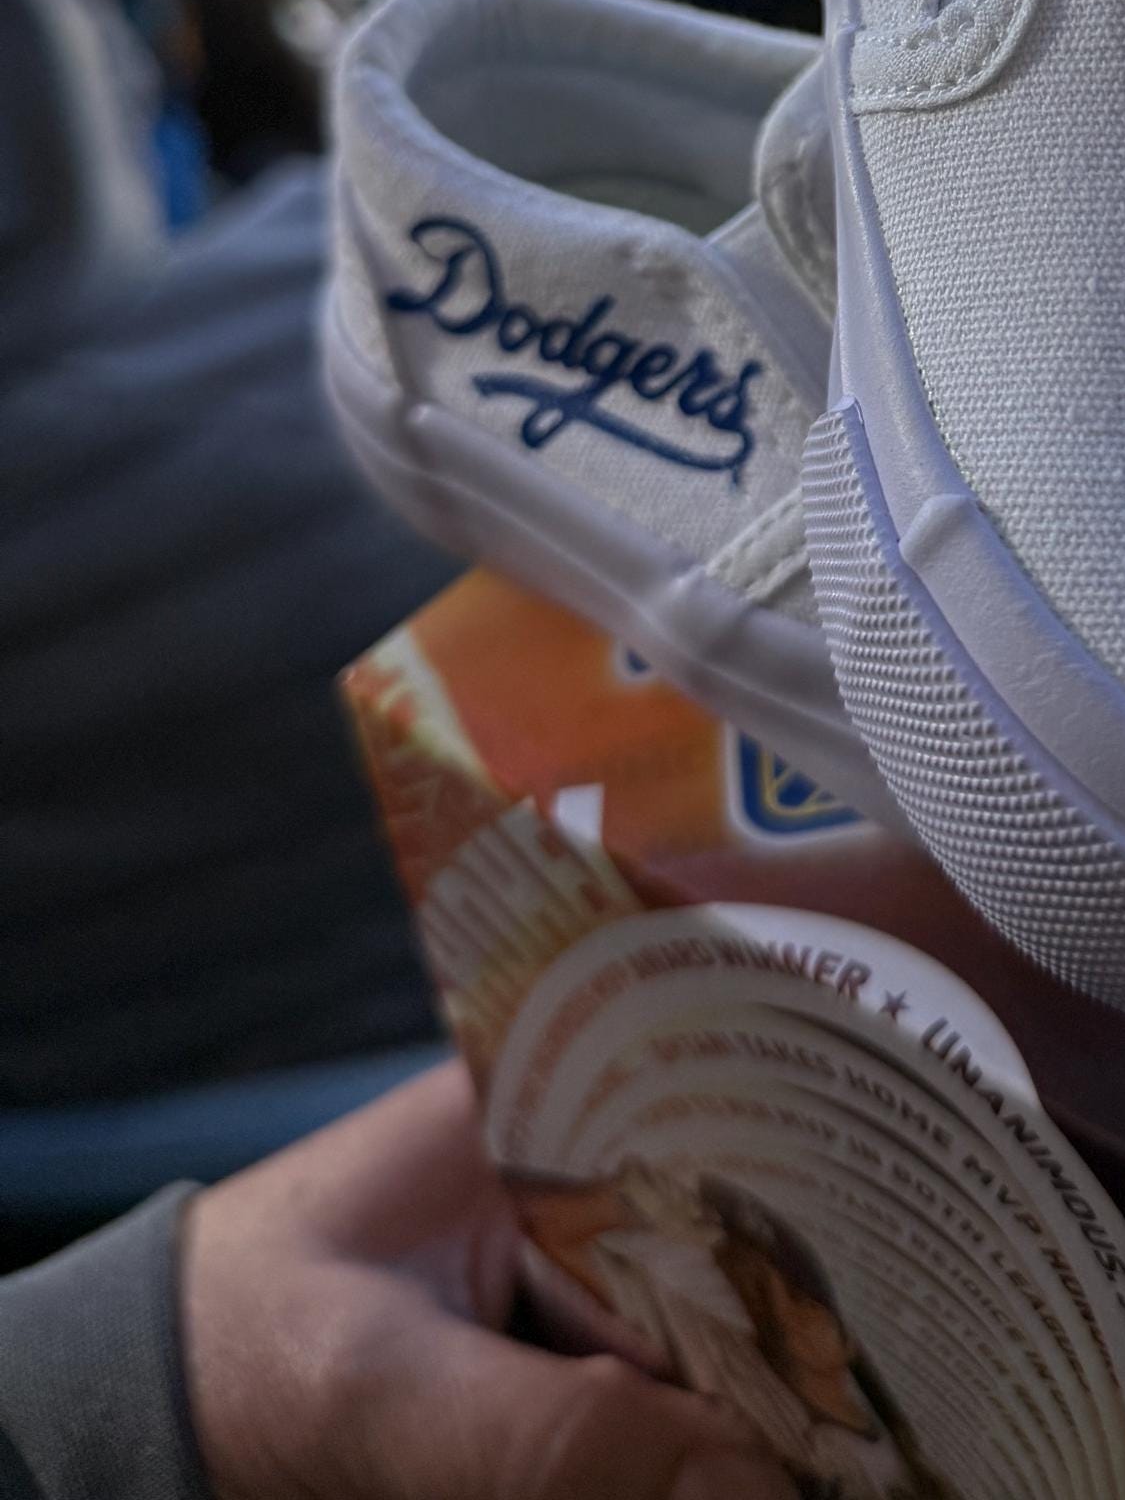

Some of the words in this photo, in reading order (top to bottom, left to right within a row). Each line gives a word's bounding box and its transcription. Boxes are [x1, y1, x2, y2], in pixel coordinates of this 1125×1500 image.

[386, 216, 762, 492] Dodgers
[845, 1065, 954, 1148] HOME
[961, 1153, 1043, 1238] MVP
